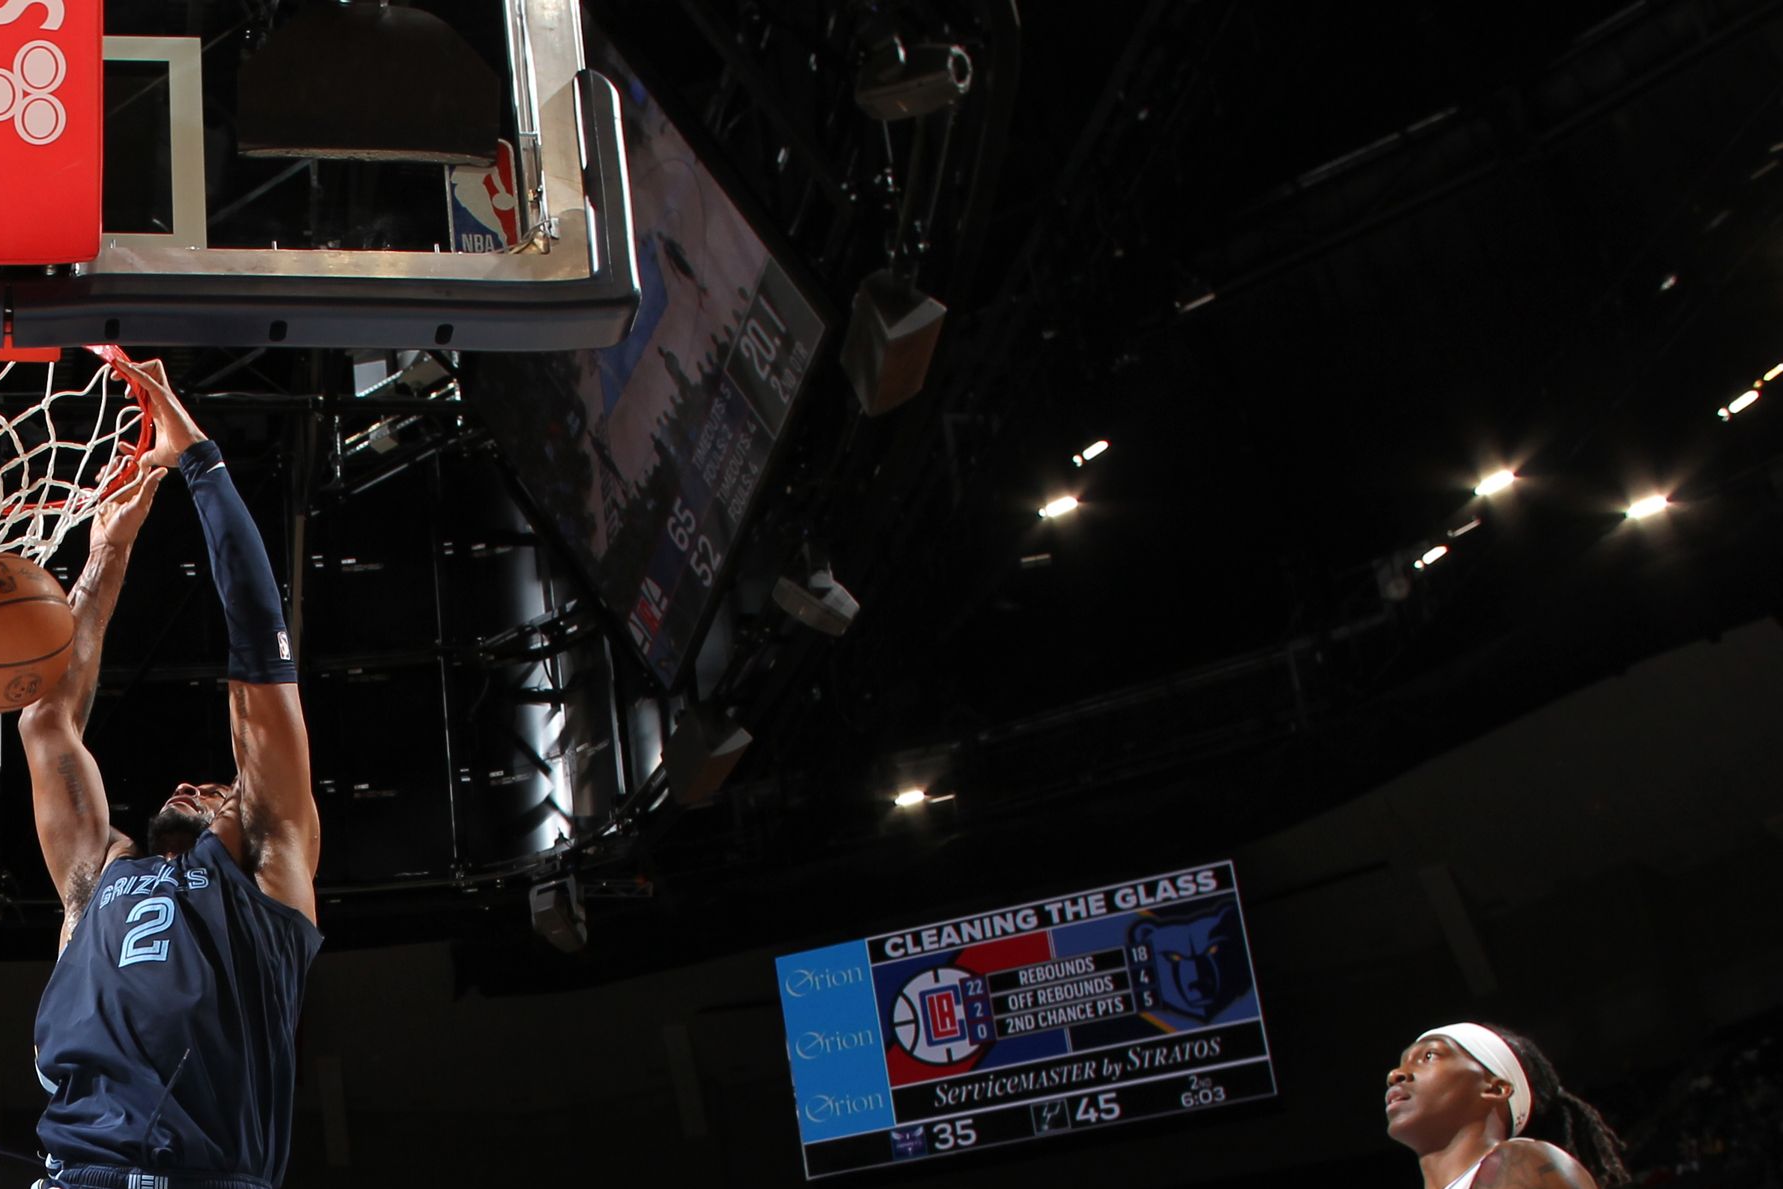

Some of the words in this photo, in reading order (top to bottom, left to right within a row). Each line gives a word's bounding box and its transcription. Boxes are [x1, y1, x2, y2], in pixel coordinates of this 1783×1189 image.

[461, 233, 495, 253] NBA
[739, 294, 787, 381] 20.1
[667, 497, 696, 552] 65
[689, 534, 722, 588] 52
[884, 905, 1039, 959] CLEANING
[1043, 892, 1107, 925] THE
[1114, 869, 1218, 910] GLASS
[118, 896, 175, 968] 2
[1131, 946, 1149, 963] 18
[785, 966, 863, 997] Orion
[1018, 956, 1096, 986] REBOUNDS
[1139, 969, 1150, 985] 4
[965, 979, 984, 997] 22
[1007, 989, 1035, 1011] OFF
[1037, 975, 1115, 1006] REBOUNDS
[1142, 990, 1154, 1007] 5
[973, 1002, 984, 1018] 2
[1006, 1012, 1036, 1035] 2ND
[1037, 1002, 1096, 1030] CHANCE
[1097, 996, 1125, 1018] PTS
[796, 1029, 874, 1059] Orion
[977, 1024, 987, 1040] 0
[1101, 1056, 1123, 1081] by
[1126, 1036, 1222, 1073] STRATOS
[805, 1092, 884, 1123] Orion
[1180, 1086, 1227, 1108] 6:03
[932, 1118, 978, 1151] 35
[1075, 1092, 1122, 1123] 45
